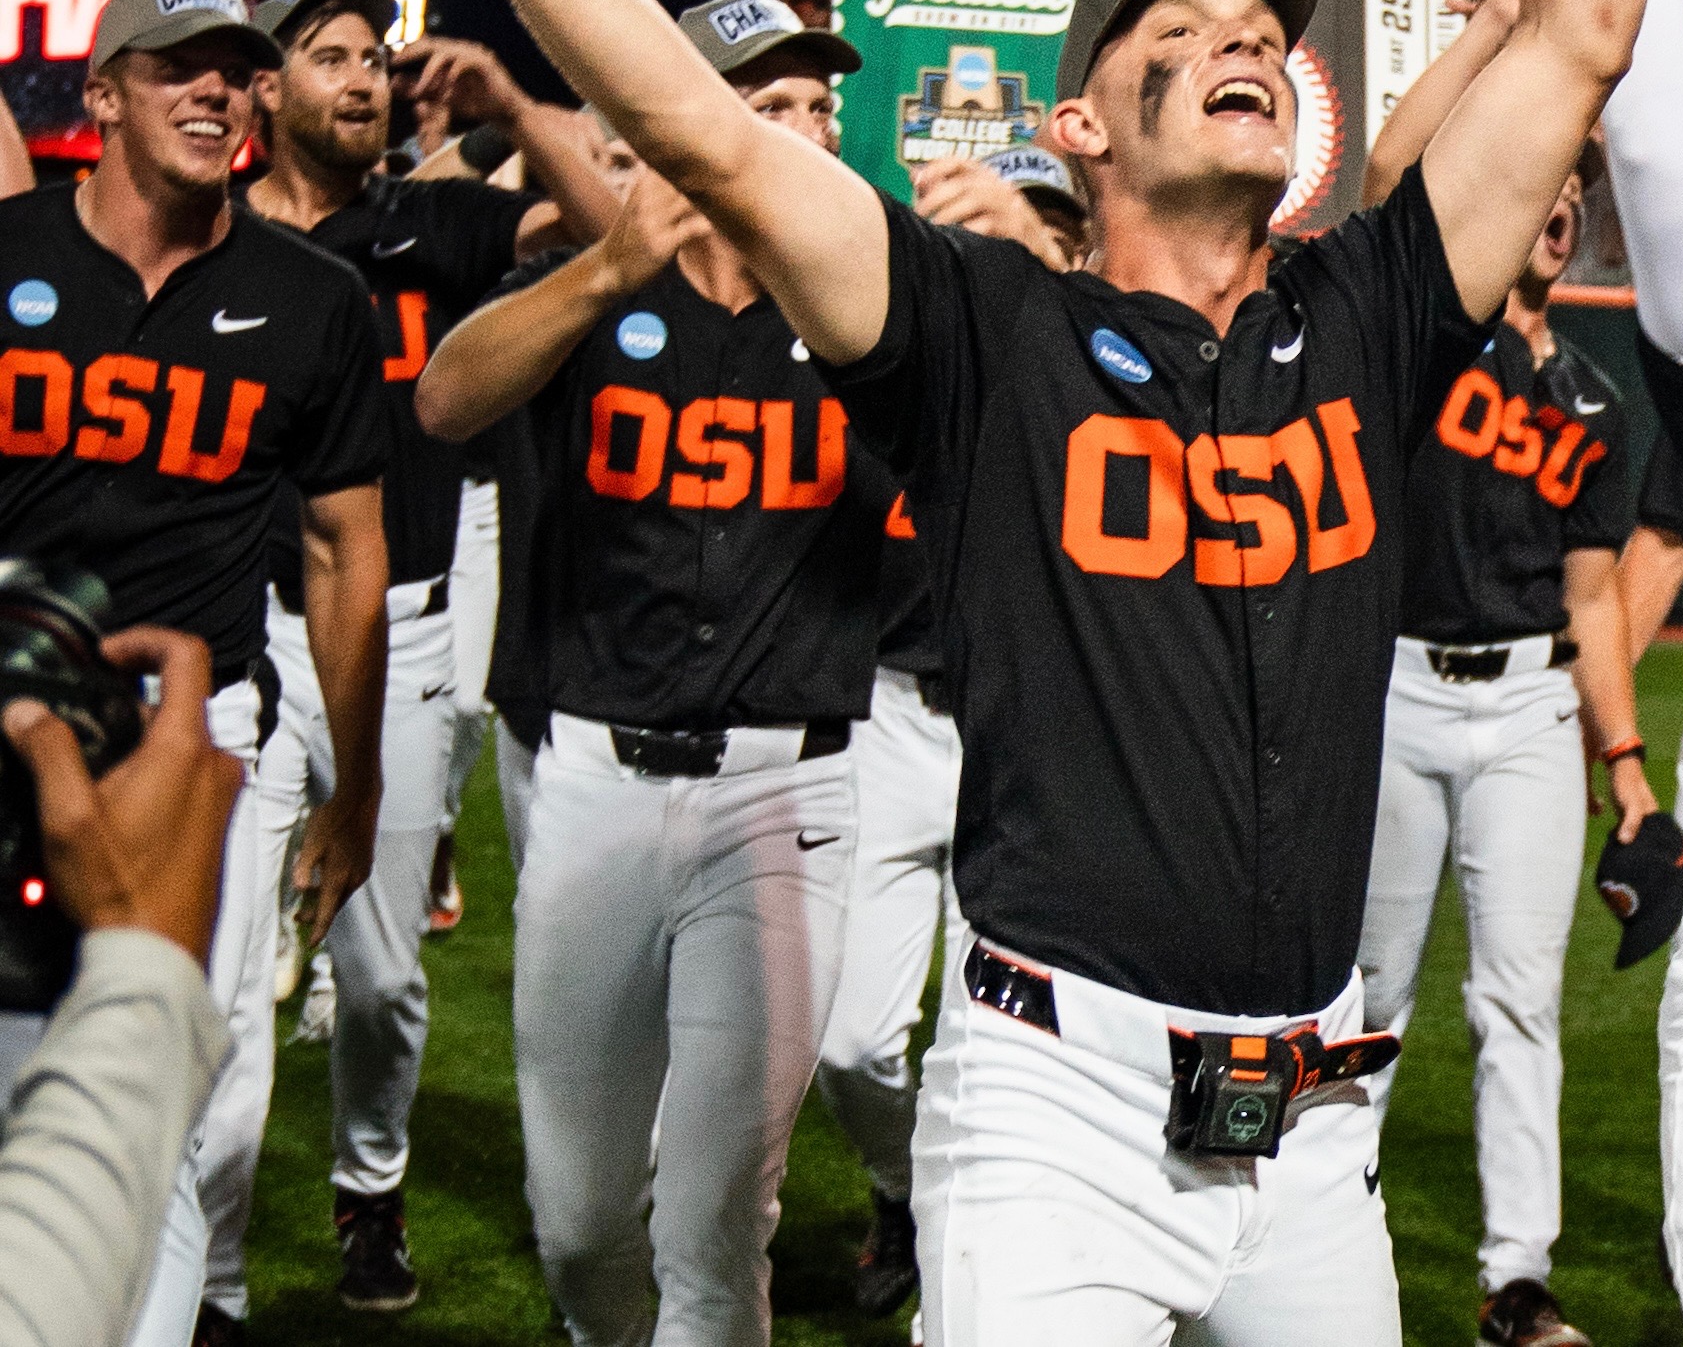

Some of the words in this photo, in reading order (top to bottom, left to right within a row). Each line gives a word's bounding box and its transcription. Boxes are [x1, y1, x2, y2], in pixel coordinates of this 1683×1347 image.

[0, 349, 266, 482] OSU
[586, 384, 849, 511] OSU
[1434, 367, 1607, 508] OSU
[1061, 396, 1377, 587] OSU
